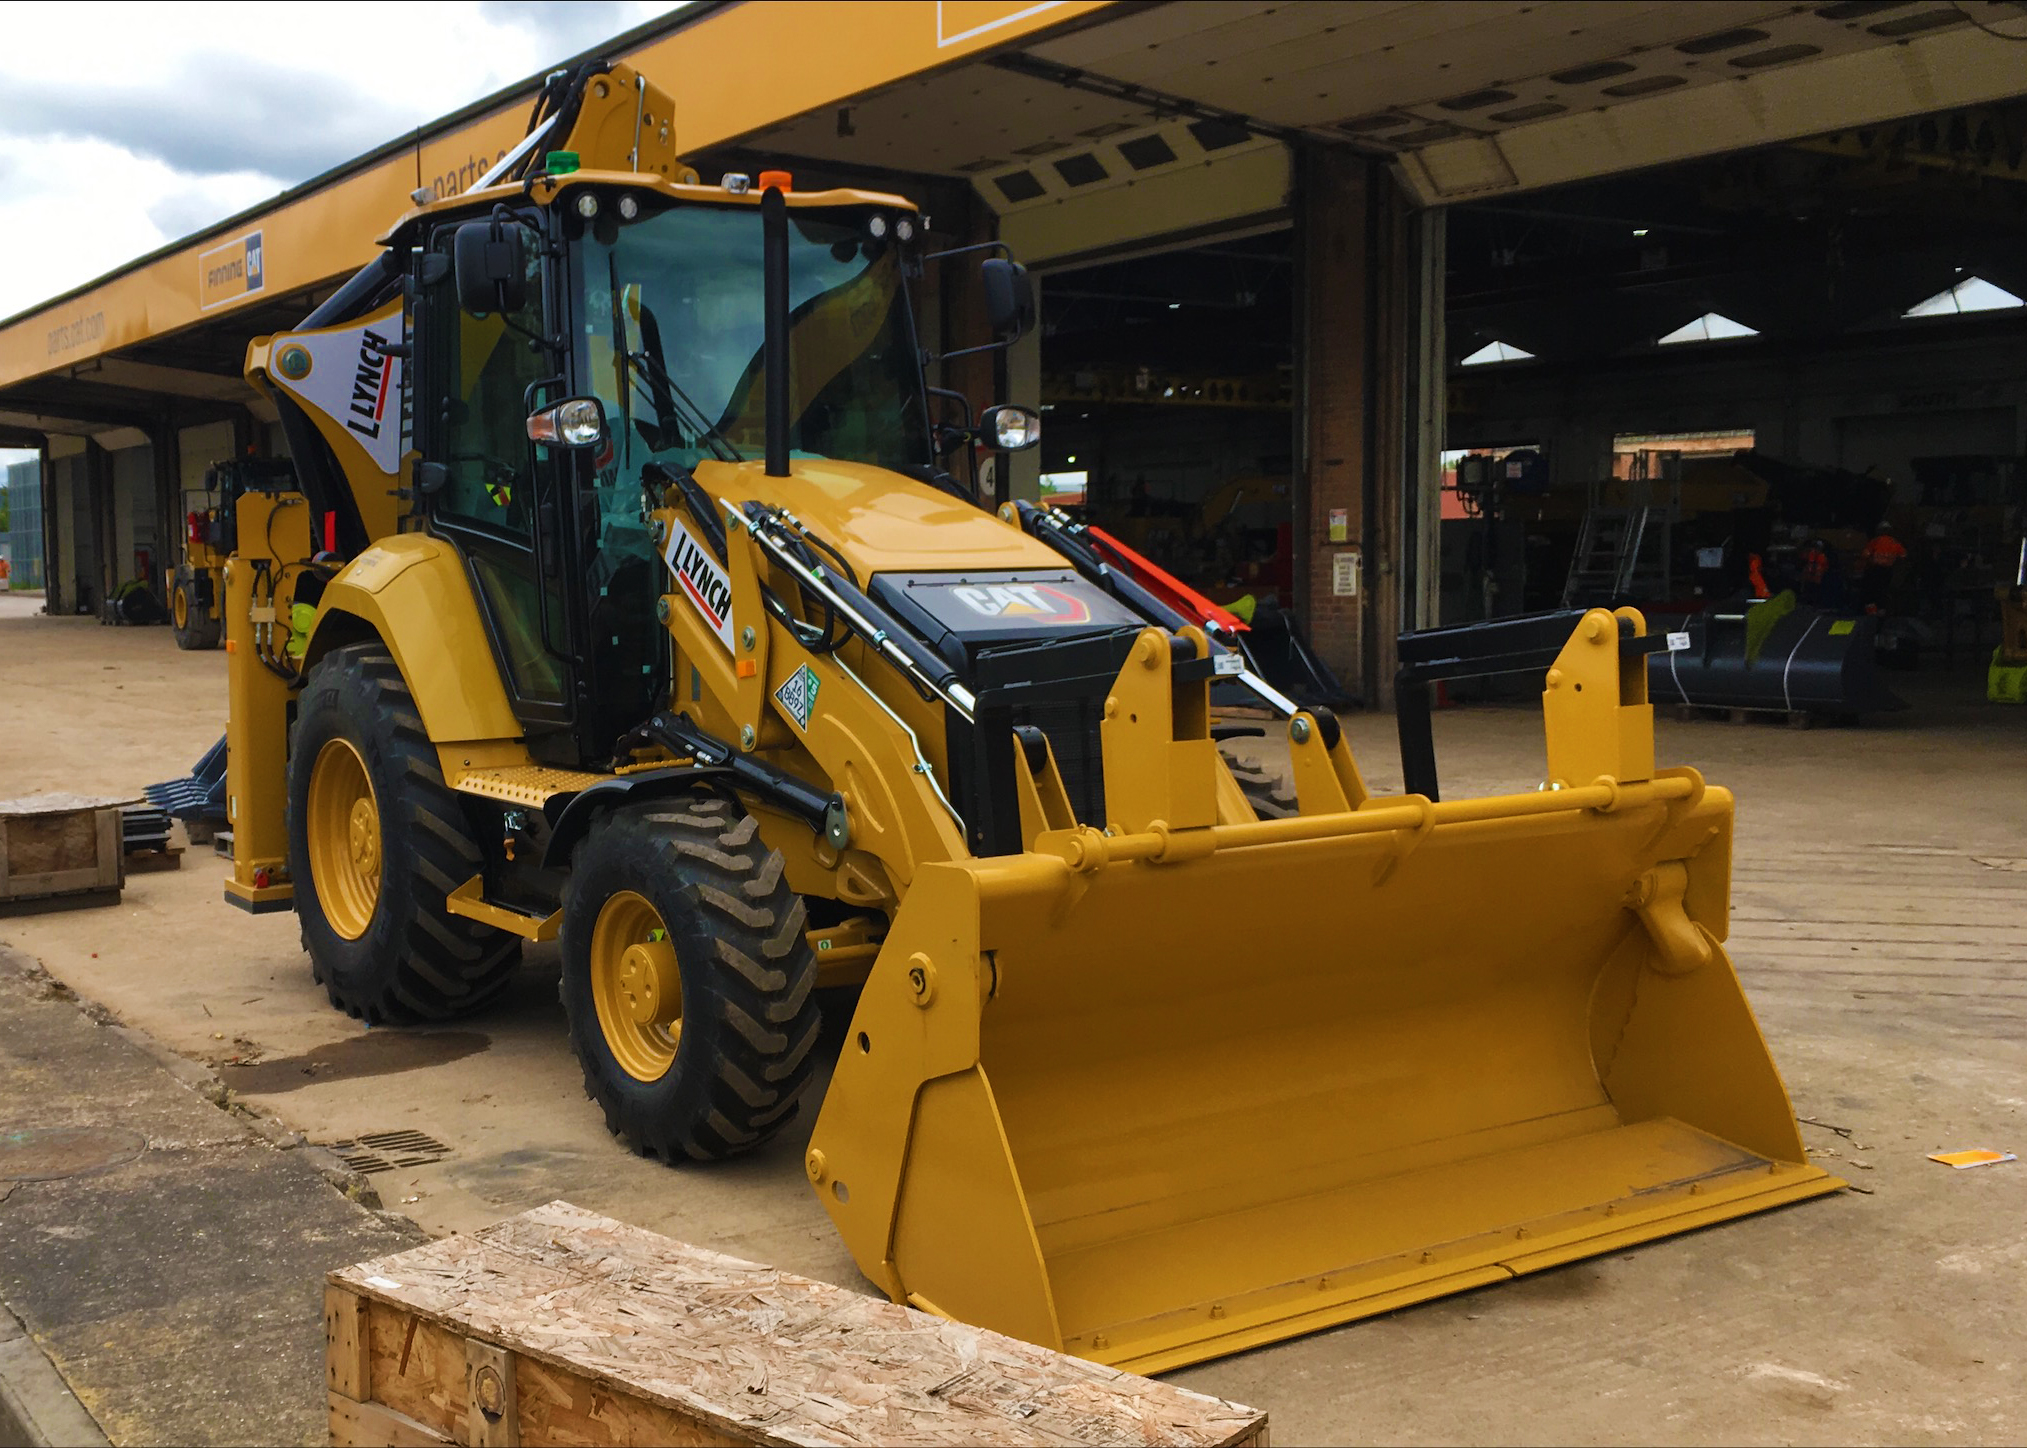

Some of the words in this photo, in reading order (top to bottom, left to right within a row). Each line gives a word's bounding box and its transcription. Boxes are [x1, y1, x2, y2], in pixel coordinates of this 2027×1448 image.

[207, 258, 243, 288] FINNING
[246, 246, 261, 277] CAT
[952, 585, 1058, 616] CAT
